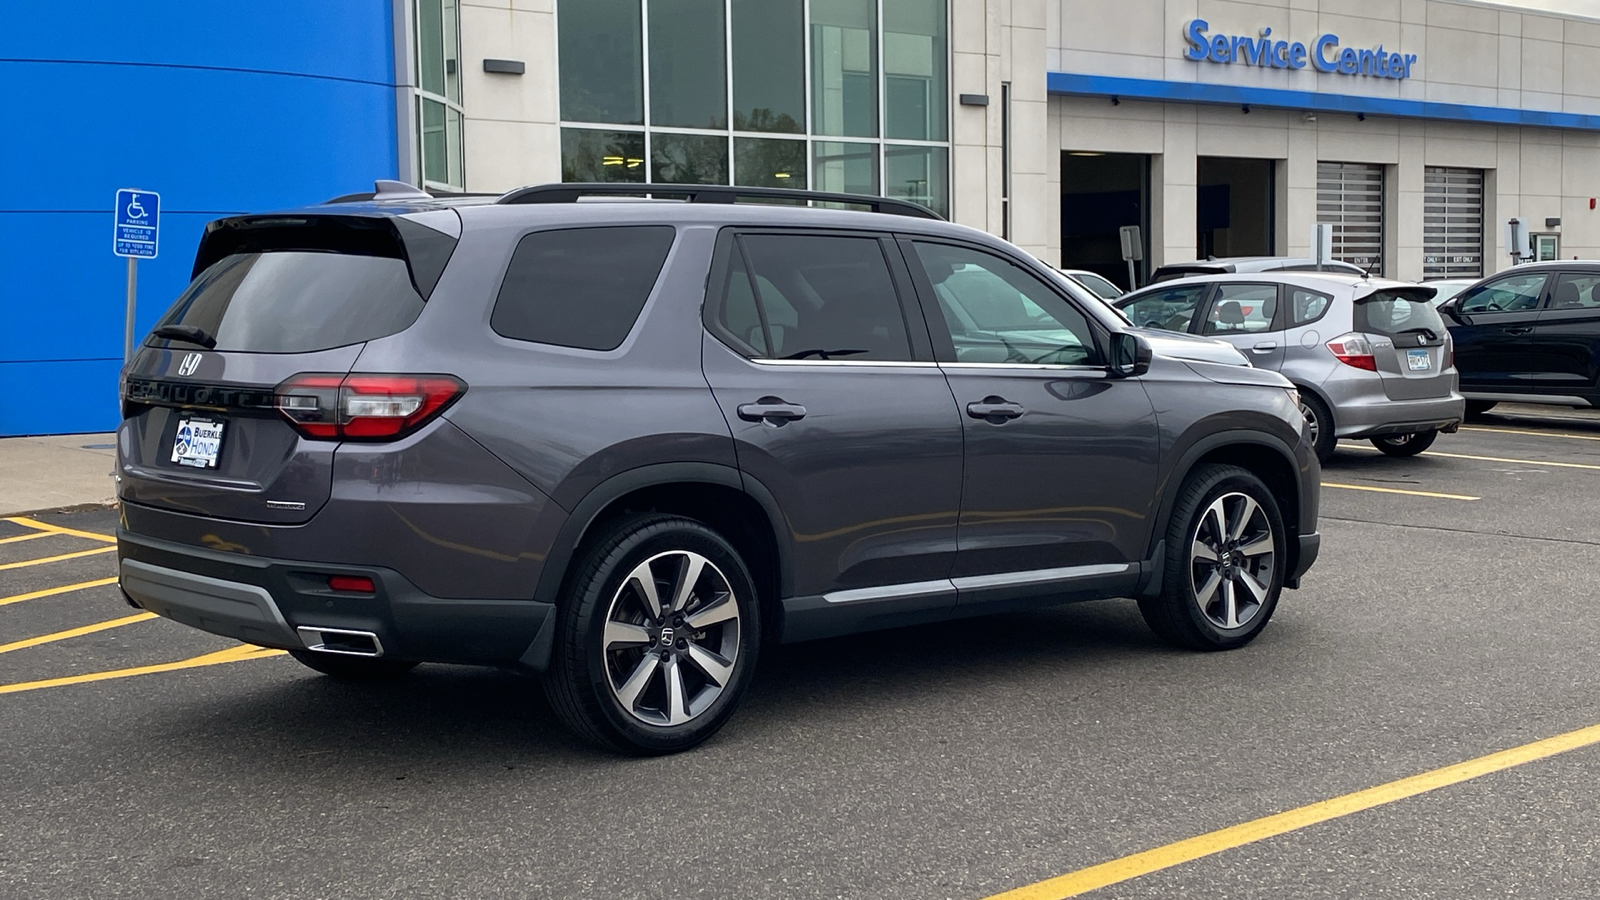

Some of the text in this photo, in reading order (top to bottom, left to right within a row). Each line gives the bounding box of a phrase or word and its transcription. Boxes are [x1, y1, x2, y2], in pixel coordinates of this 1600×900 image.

[1184, 19, 1417, 79] Service Center
[190, 438, 219, 456] HONDA
